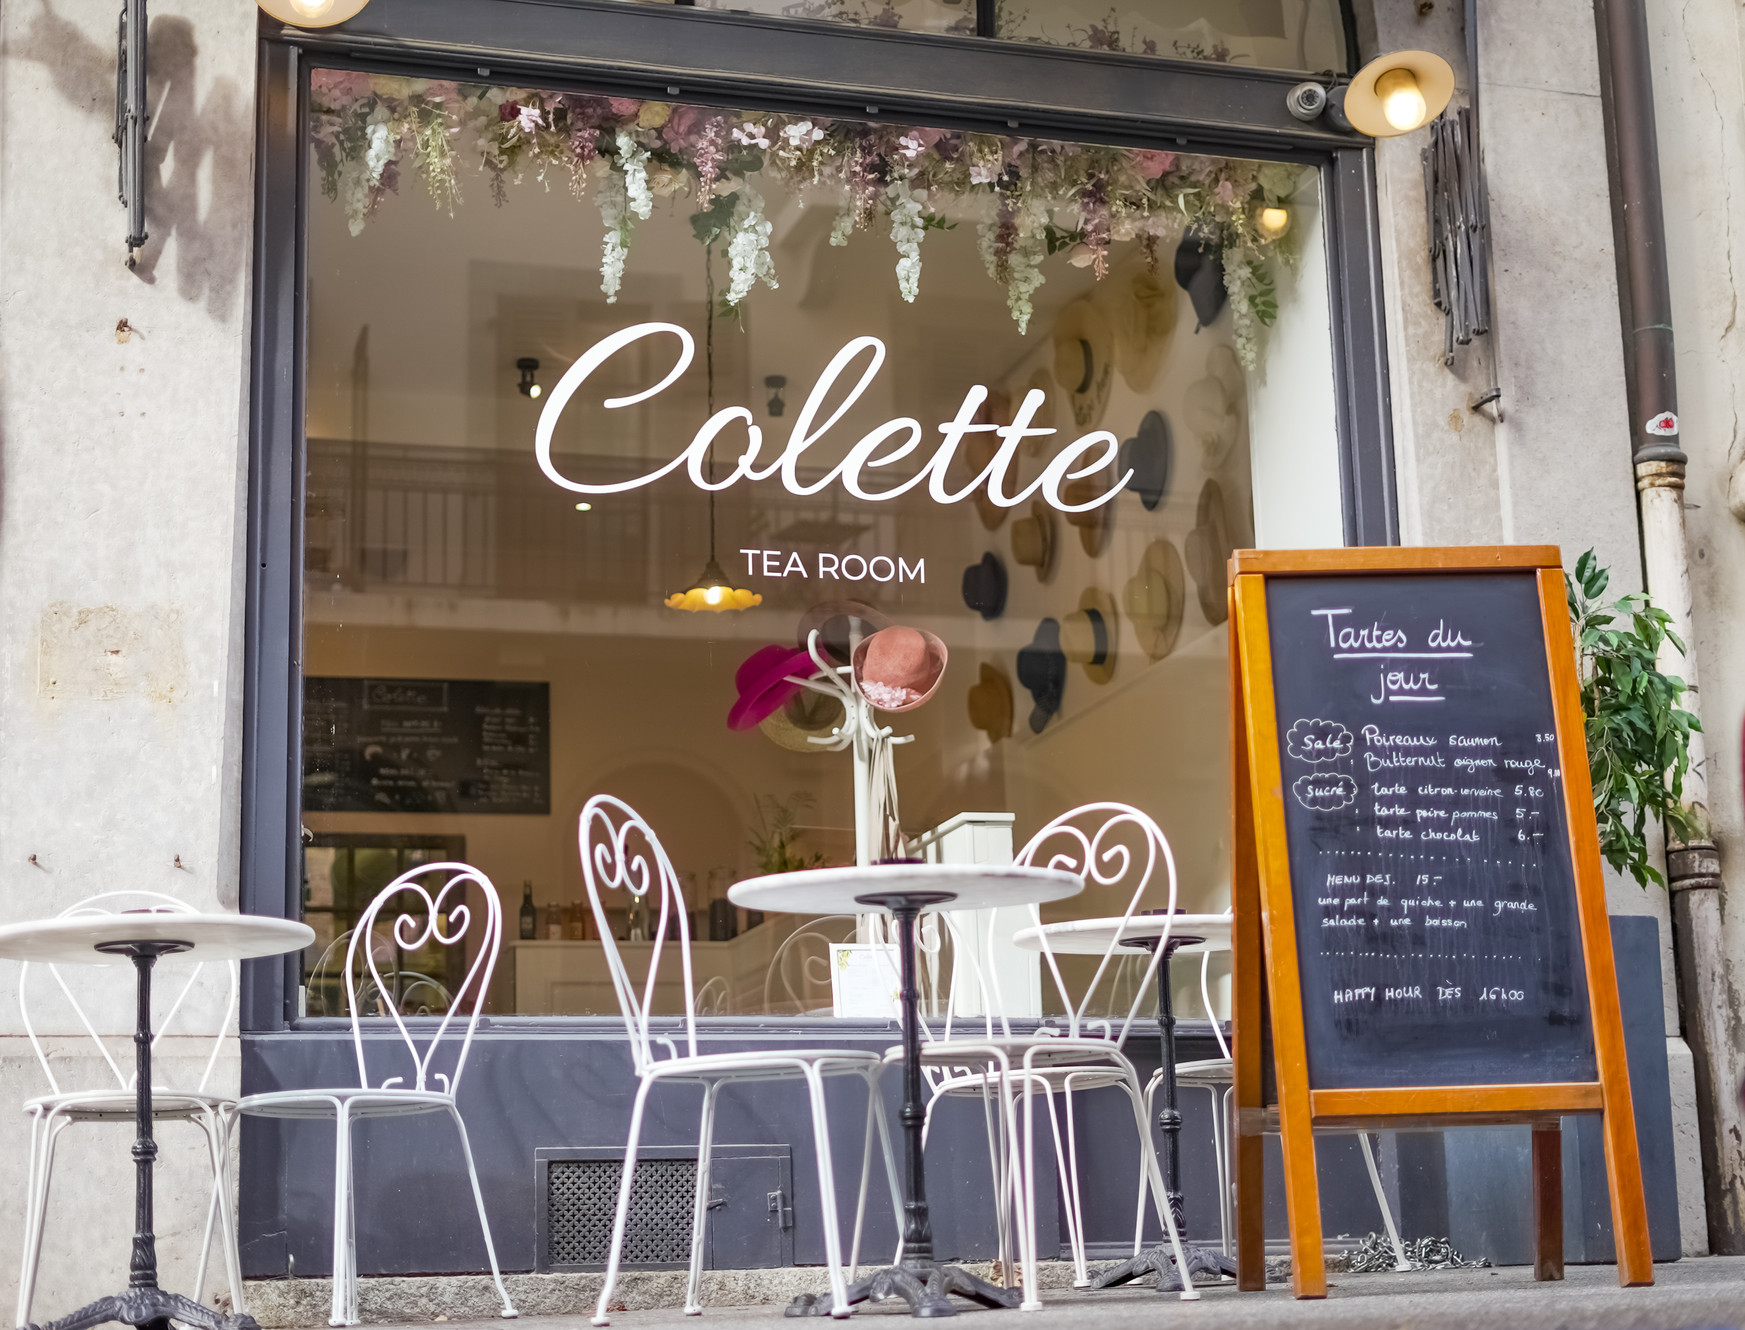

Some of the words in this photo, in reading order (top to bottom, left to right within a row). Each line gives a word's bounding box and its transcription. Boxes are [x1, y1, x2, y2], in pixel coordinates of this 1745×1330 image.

[535, 321, 1134, 513] Colette
[740, 549, 806, 578] TEA
[818, 553, 926, 584] ROOM
[1311, 609, 1406, 648] Tartes
[1428, 619, 1472, 647] du
[1371, 665, 1438, 704] jour
[1361, 725, 1437, 747] Poireaux
[1449, 735, 1502, 746] saumon
[1364, 752, 1445, 771] Butternut
[1454, 757, 1496, 773] oignon
[1504, 759, 1545, 775] rouge
[1371, 783, 1407, 795] tarte
[1515, 785, 1543, 797] 5.80
[1374, 802, 1410, 815] tarte
[1416, 808, 1448, 822] poire
[1450, 811, 1498, 826] pommes
[1377, 826, 1412, 838] tarte
[1421, 828, 1480, 841] chocolat
[1327, 874, 1361, 887] MENU
[1317, 897, 1340, 905] une
[1344, 892, 1368, 910] part
[1377, 896, 1389, 905] de
[1401, 897, 1443, 914] quiche
[1463, 899, 1484, 907] une
[1493, 900, 1537, 916] grande
[1322, 915, 1365, 926] salade
[1390, 917, 1412, 926] une
[1334, 987, 1375, 1003] HAPPY
[1386, 986, 1422, 1000] HOUR
